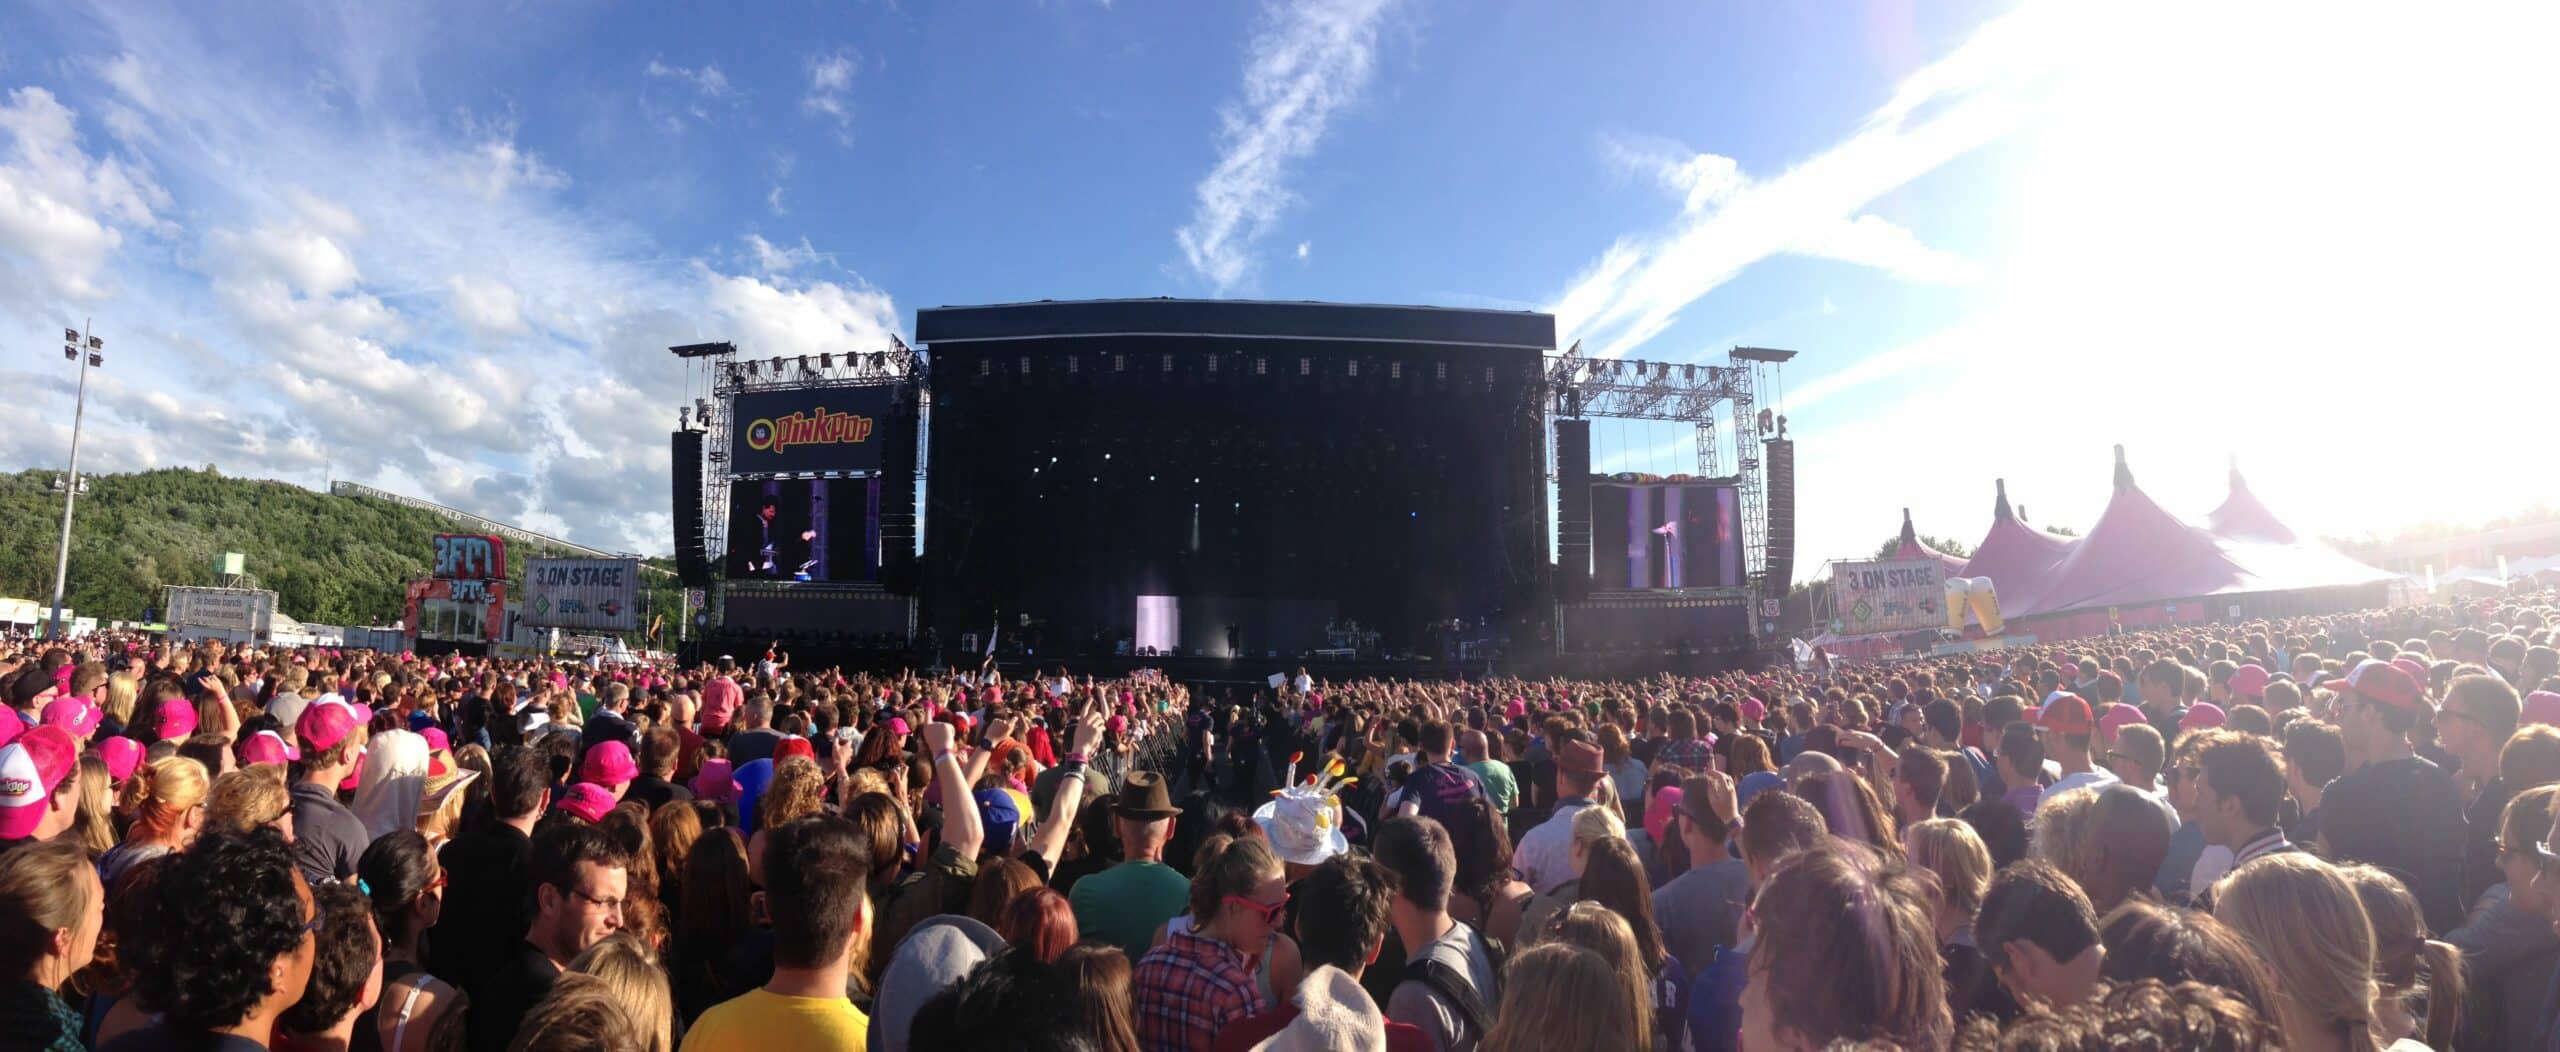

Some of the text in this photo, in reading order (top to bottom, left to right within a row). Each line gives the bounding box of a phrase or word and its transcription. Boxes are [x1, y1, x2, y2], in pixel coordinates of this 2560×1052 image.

[357, 485, 390, 500] HOTEL
[481, 521, 535, 543] OUTDOOR
[434, 536, 493, 576] 3FM
[536, 566, 623, 587] 3 ON STAGE
[1849, 567, 1934, 590] 3 ON STAGE
